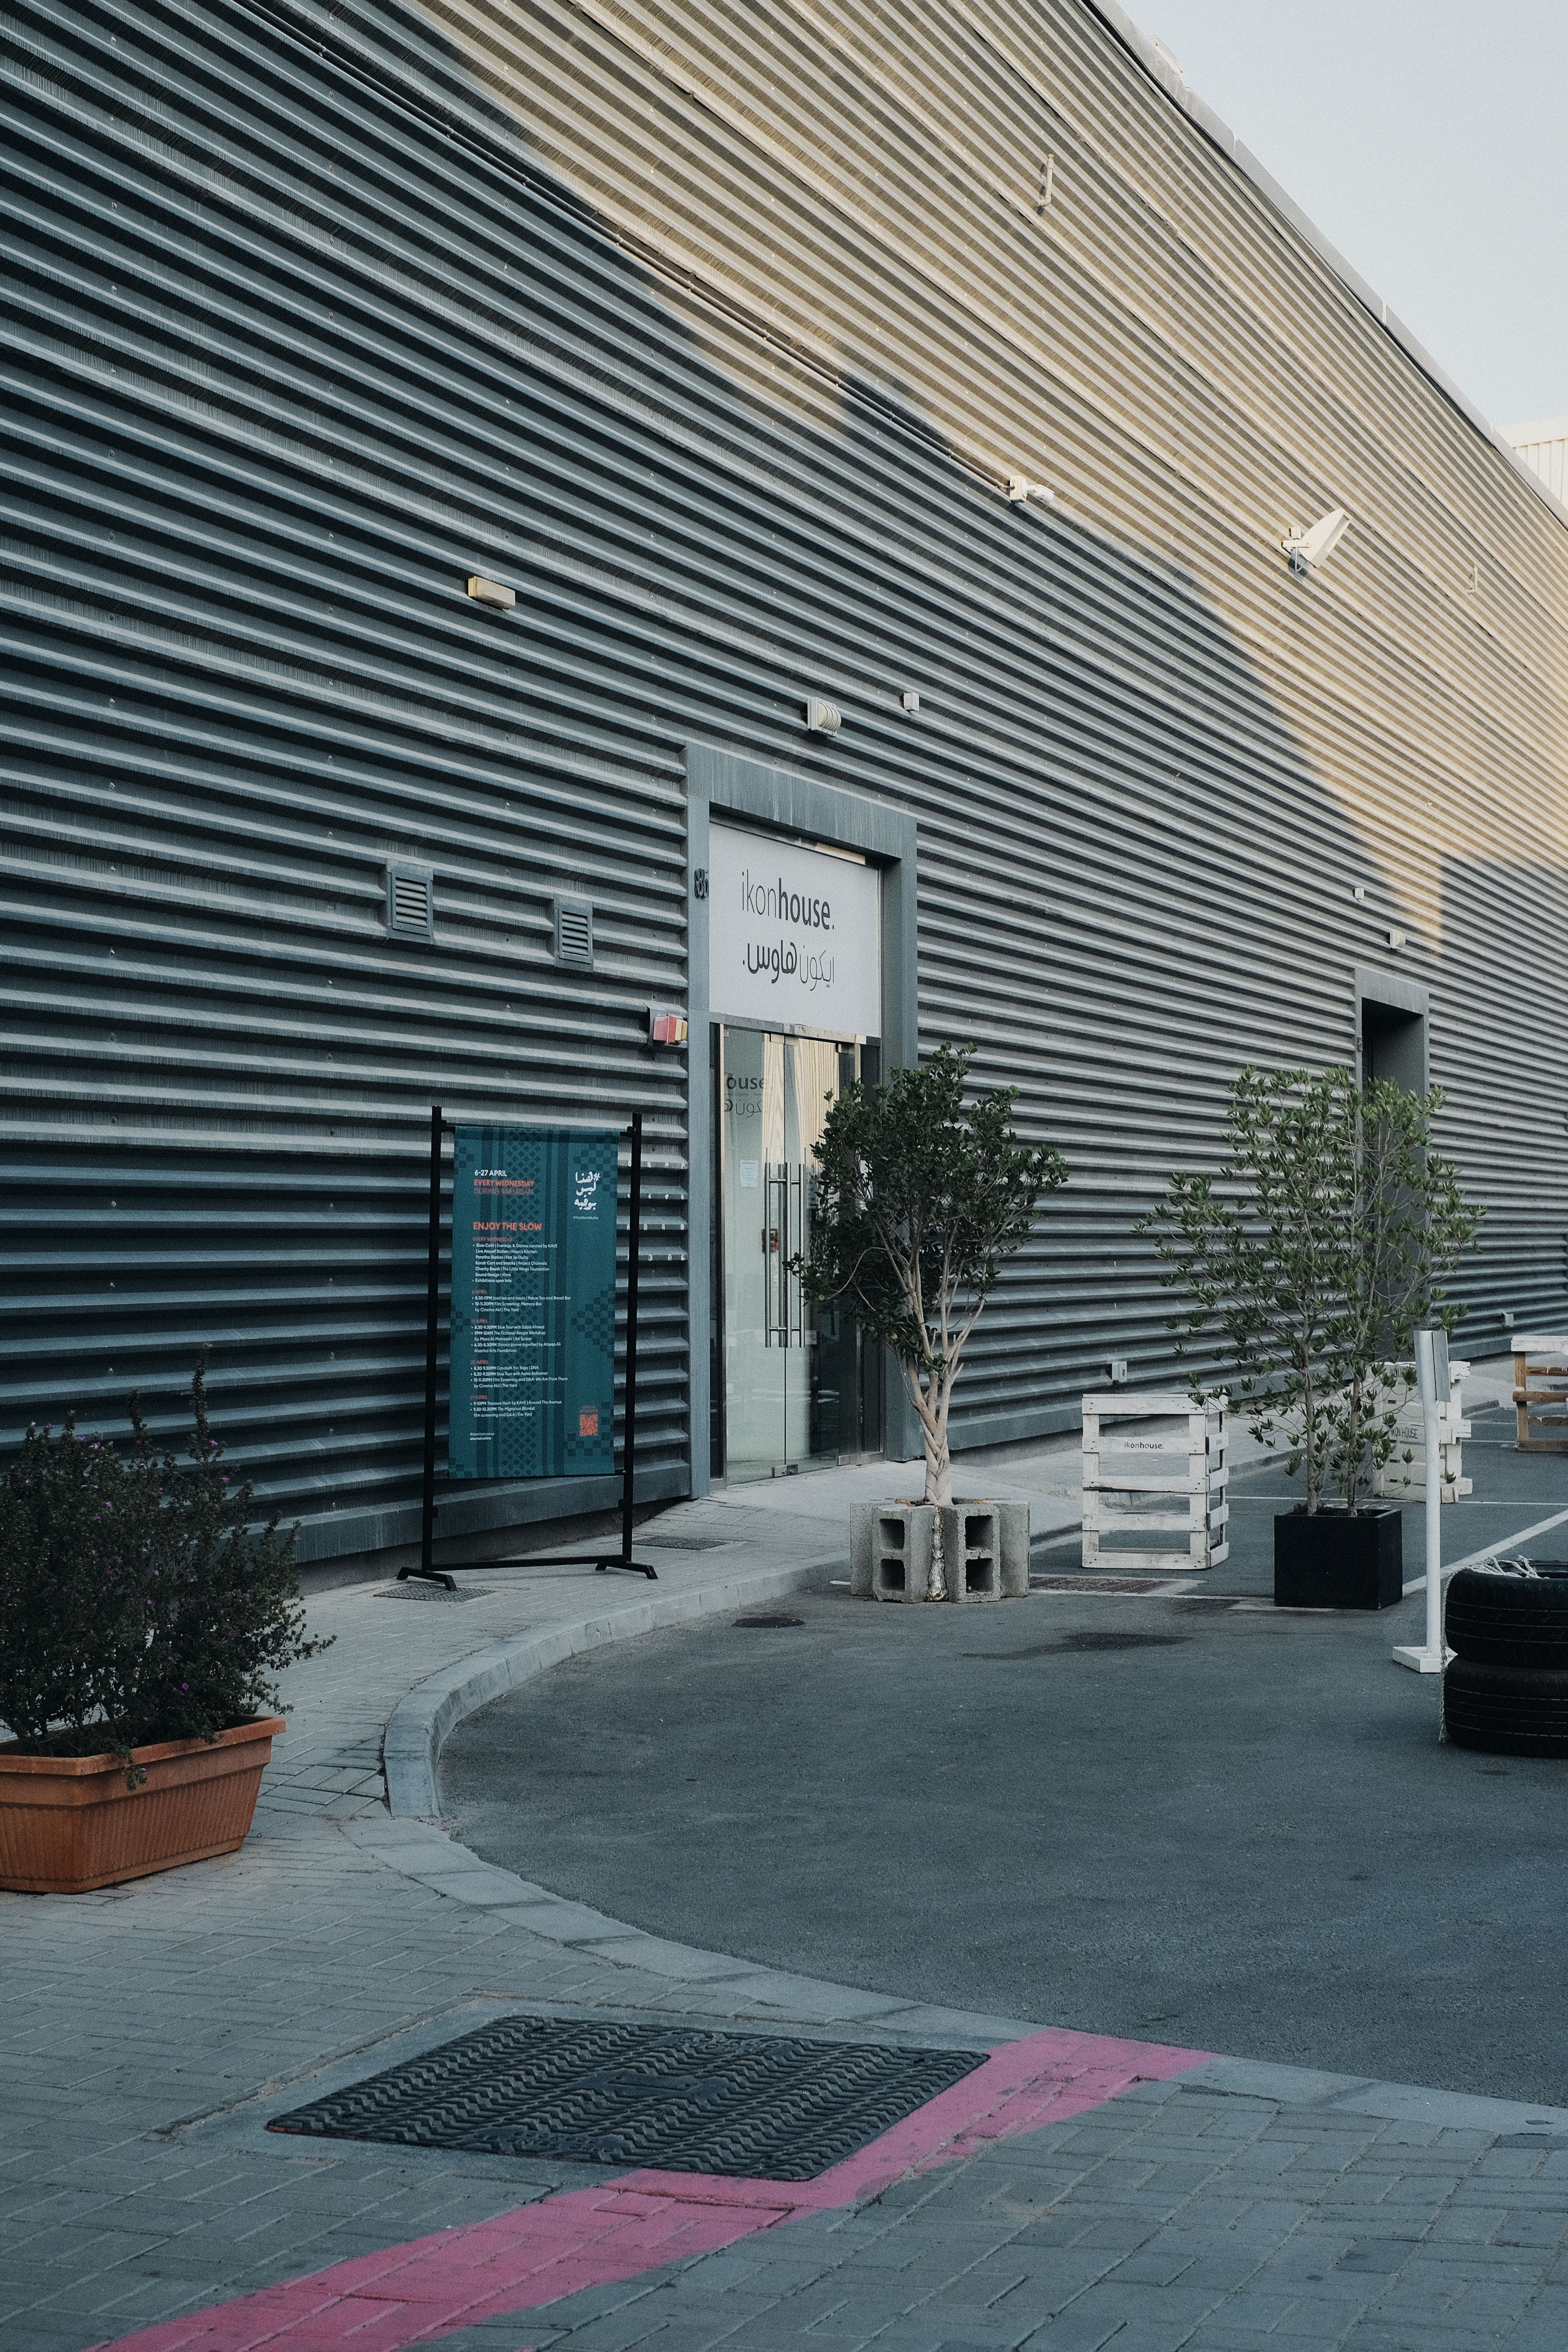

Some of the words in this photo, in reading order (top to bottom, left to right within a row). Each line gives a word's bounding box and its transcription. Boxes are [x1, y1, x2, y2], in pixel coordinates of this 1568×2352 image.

[741, 869, 835, 930] ikonhouse.
[1402, 1427, 1418, 1439] HOUSE
[1124, 1441, 1164, 1450] ikonhouse.
